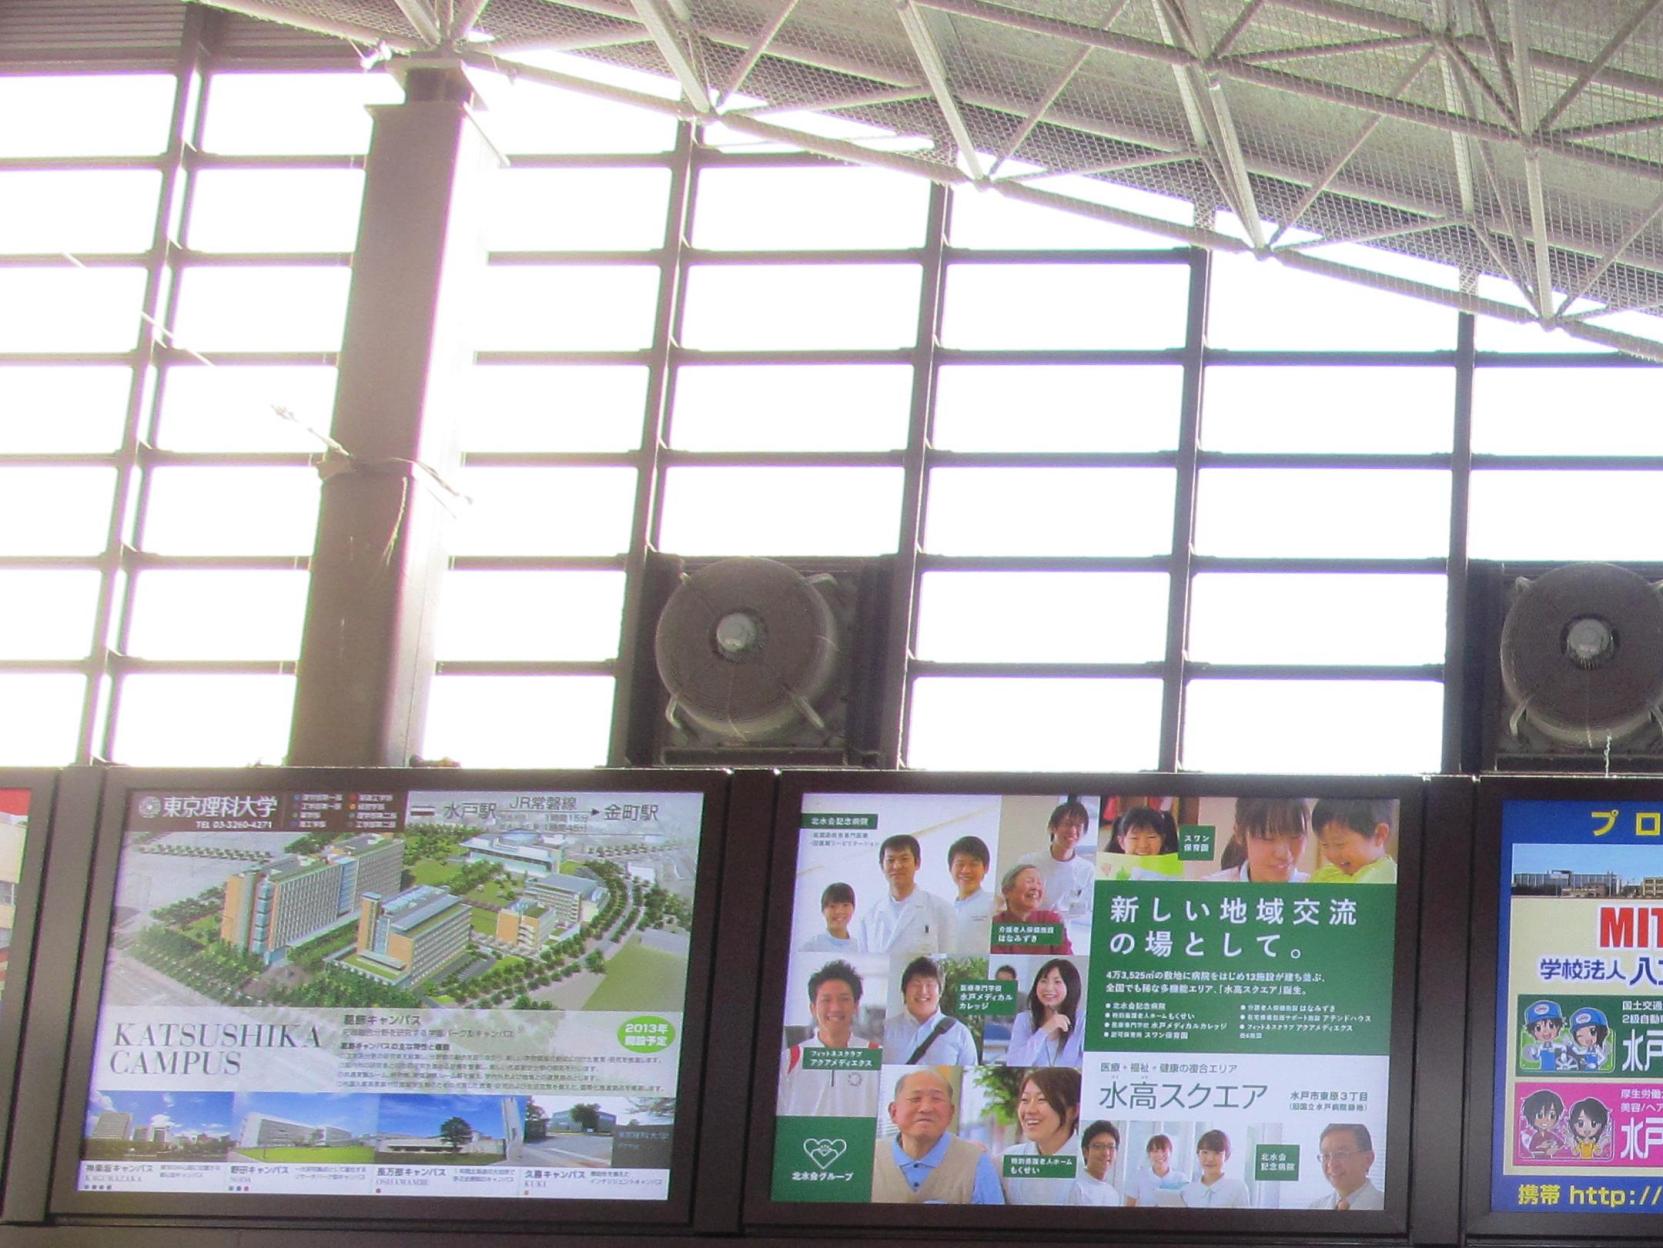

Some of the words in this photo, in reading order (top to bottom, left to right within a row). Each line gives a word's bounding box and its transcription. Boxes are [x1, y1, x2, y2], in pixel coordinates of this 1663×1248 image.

[163, 796, 277, 817] 東京理科大学
[443, 803, 497, 819] 水戸駅
[510, 797, 576, 810] JR常磐線
[605, 804, 658, 821] 金町駅
[213, 821, 272, 829] 03-3260-4271
[1111, 896, 1357, 925] 新しい地域交流
[1110, 931, 1300, 958] の場として。
[1540, 959, 1626, 980] 学校法人
[959, 993, 1012, 1001] 水戸メディカル
[114, 1023, 321, 1048] KATSUSHIKA
[625, 1023, 667, 1035] 2013年
[110, 1050, 241, 1075] CAMPUS
[810, 1059, 872, 1067] アクアメディエクス
[1100, 1081, 1267, 1109] 水高スクエア
[792, 1172, 853, 1180] 北水会グループ
[1011, 1166, 1040, 1174] もくせい
[1519, 1184, 1560, 1205] 携帯
